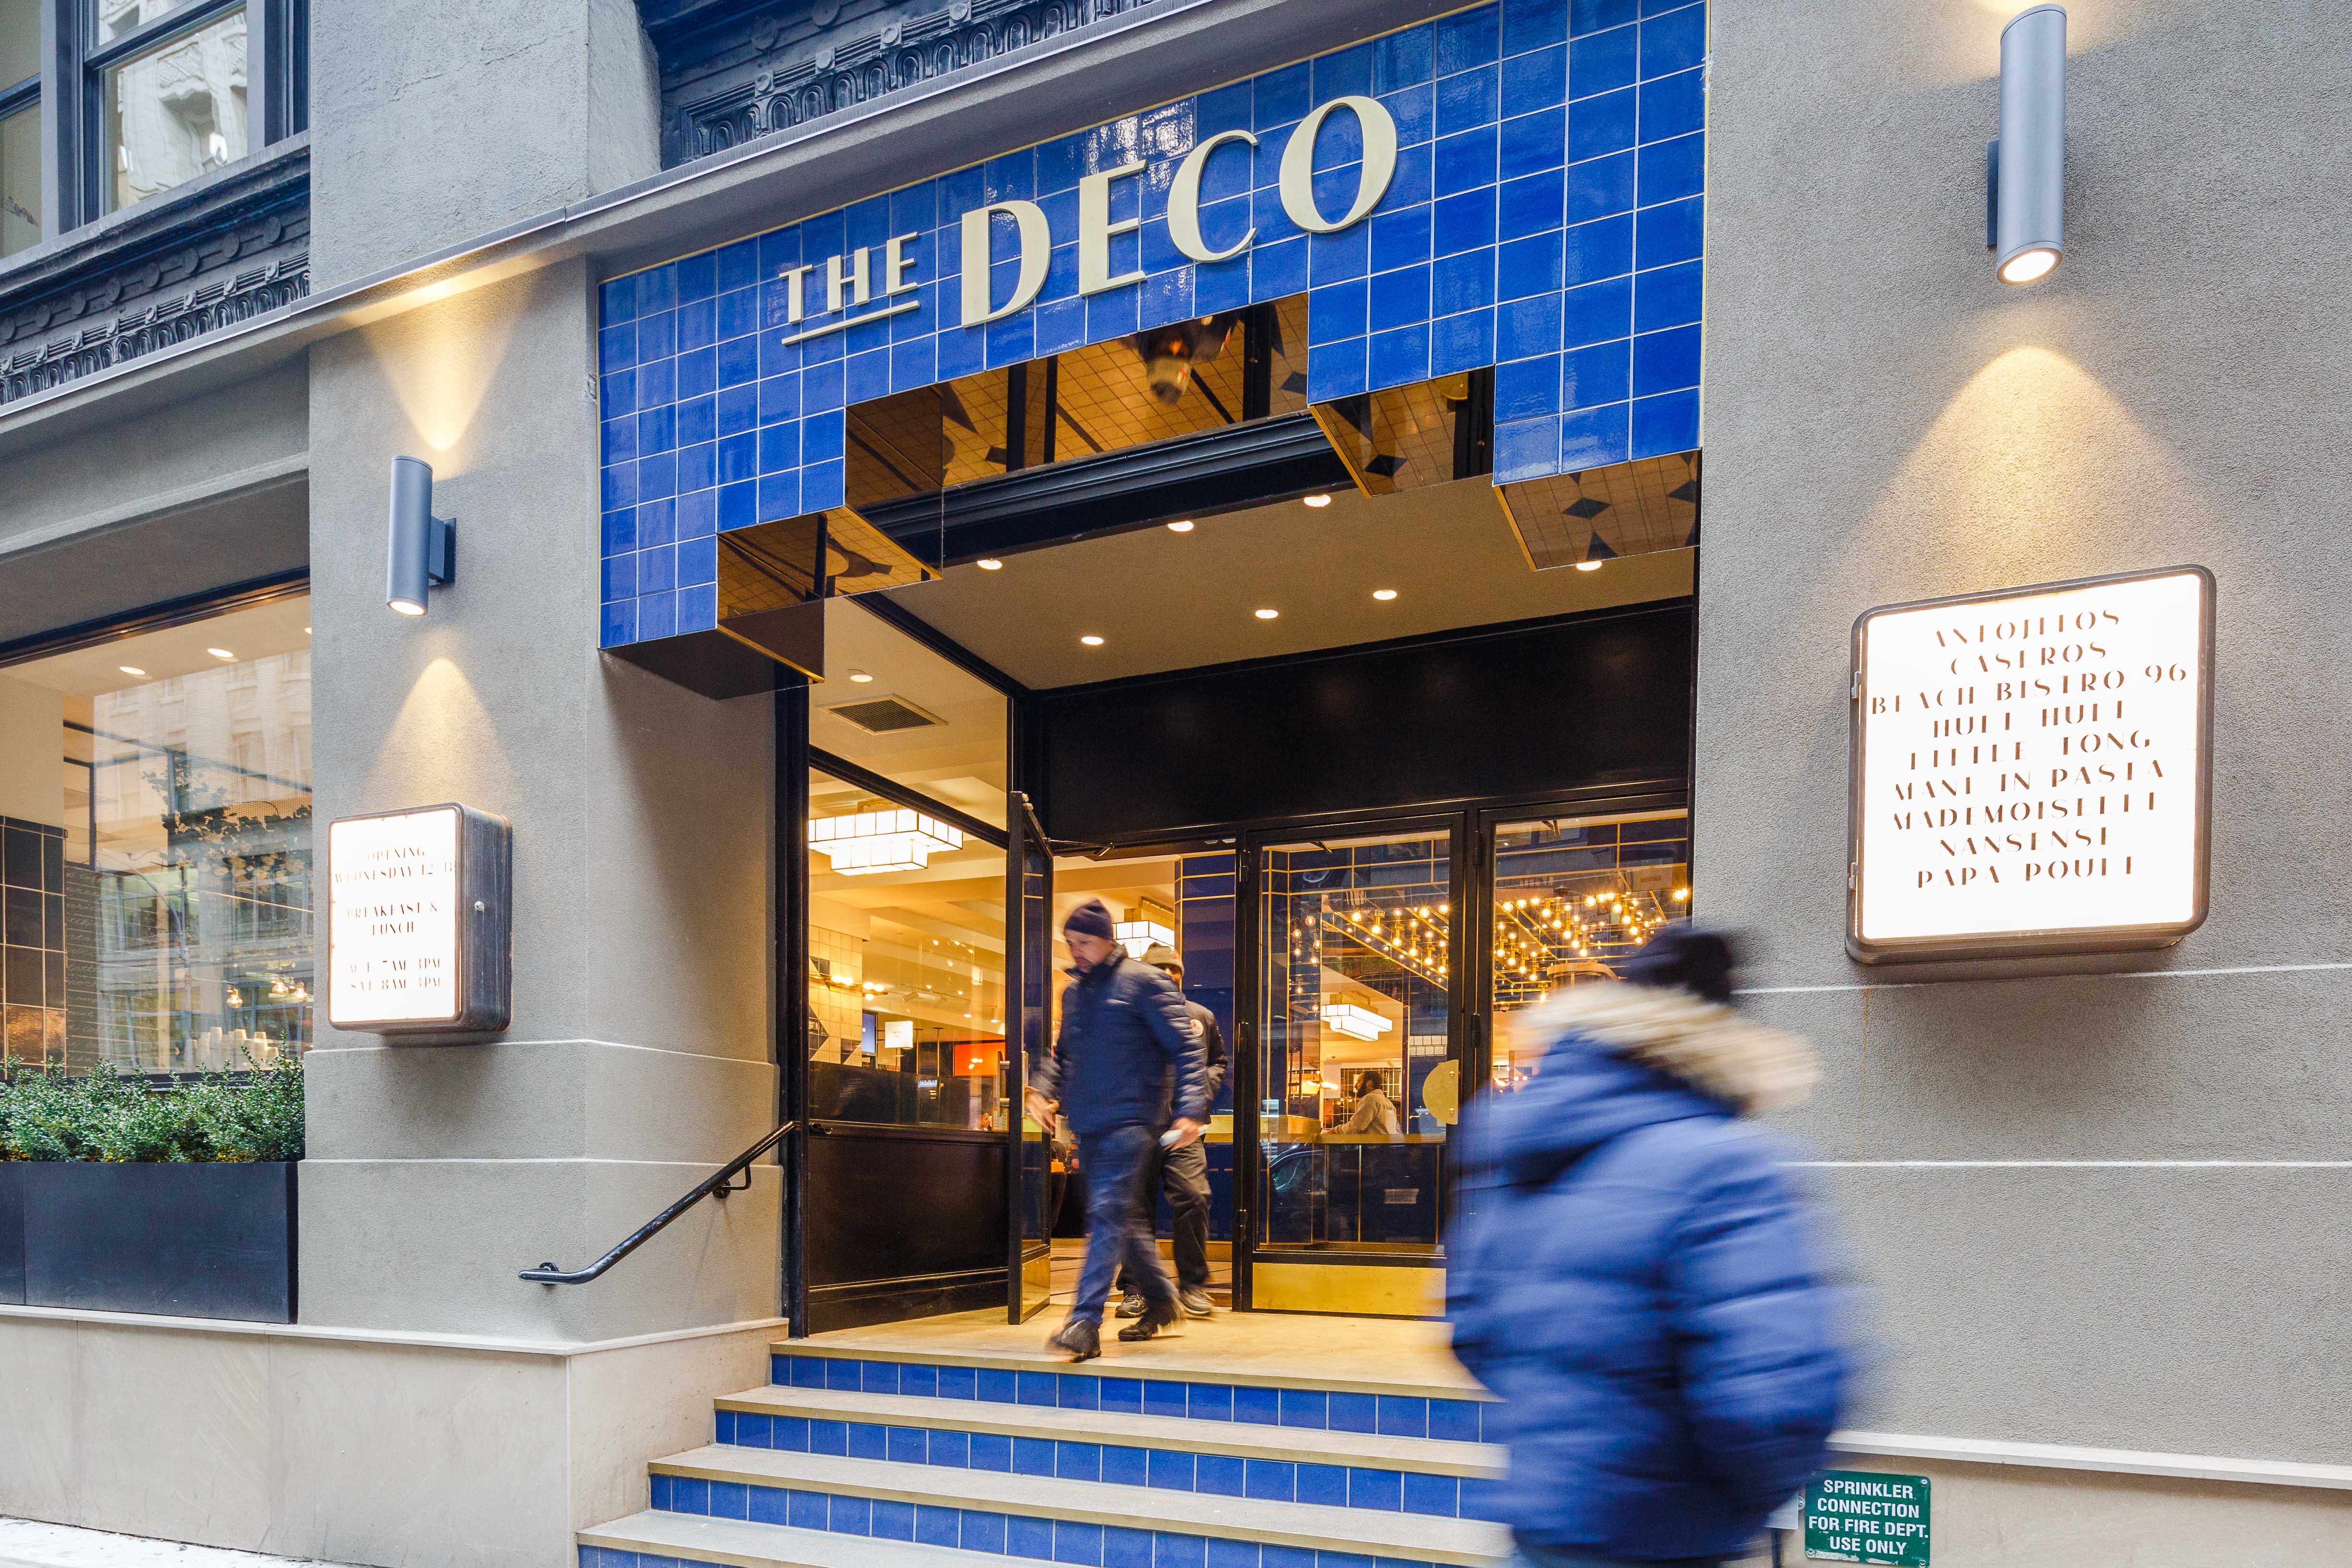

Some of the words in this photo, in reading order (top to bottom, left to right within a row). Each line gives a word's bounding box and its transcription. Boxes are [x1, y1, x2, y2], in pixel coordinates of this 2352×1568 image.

[779, 231, 920, 323] THE
[961, 95, 1398, 327] DECO
[1951, 641, 2106, 675] CASEROS
[1872, 686, 1974, 715] BEACH
[1996, 670, 2125, 702] BISTRO
[2145, 663, 2187, 683] 96
[1911, 740, 2026, 770] LITTLE
[2061, 729, 2151, 755] TONG
[1895, 775, 1972, 801] MANI
[2000, 771, 2031, 792] IN
[2051, 759, 2164, 790] PASTA
[1893, 791, 2155, 830] MADEMOISELLE
[1940, 826, 2108, 857] NANSENSE
[1918, 865, 2000, 888] PAPA
[1824, 1479, 1914, 1499] SPRINKLER
[1817, 1497, 1919, 1518] CONNECTION
[1809, 1516, 1840, 1531] FOR
[1845, 1519, 1879, 1534] FIRE
[1885, 1522, 1929, 1538] DEPT.
[1830, 1536, 1860, 1551] USE
[1866, 1539, 1907, 1555] ONLY
